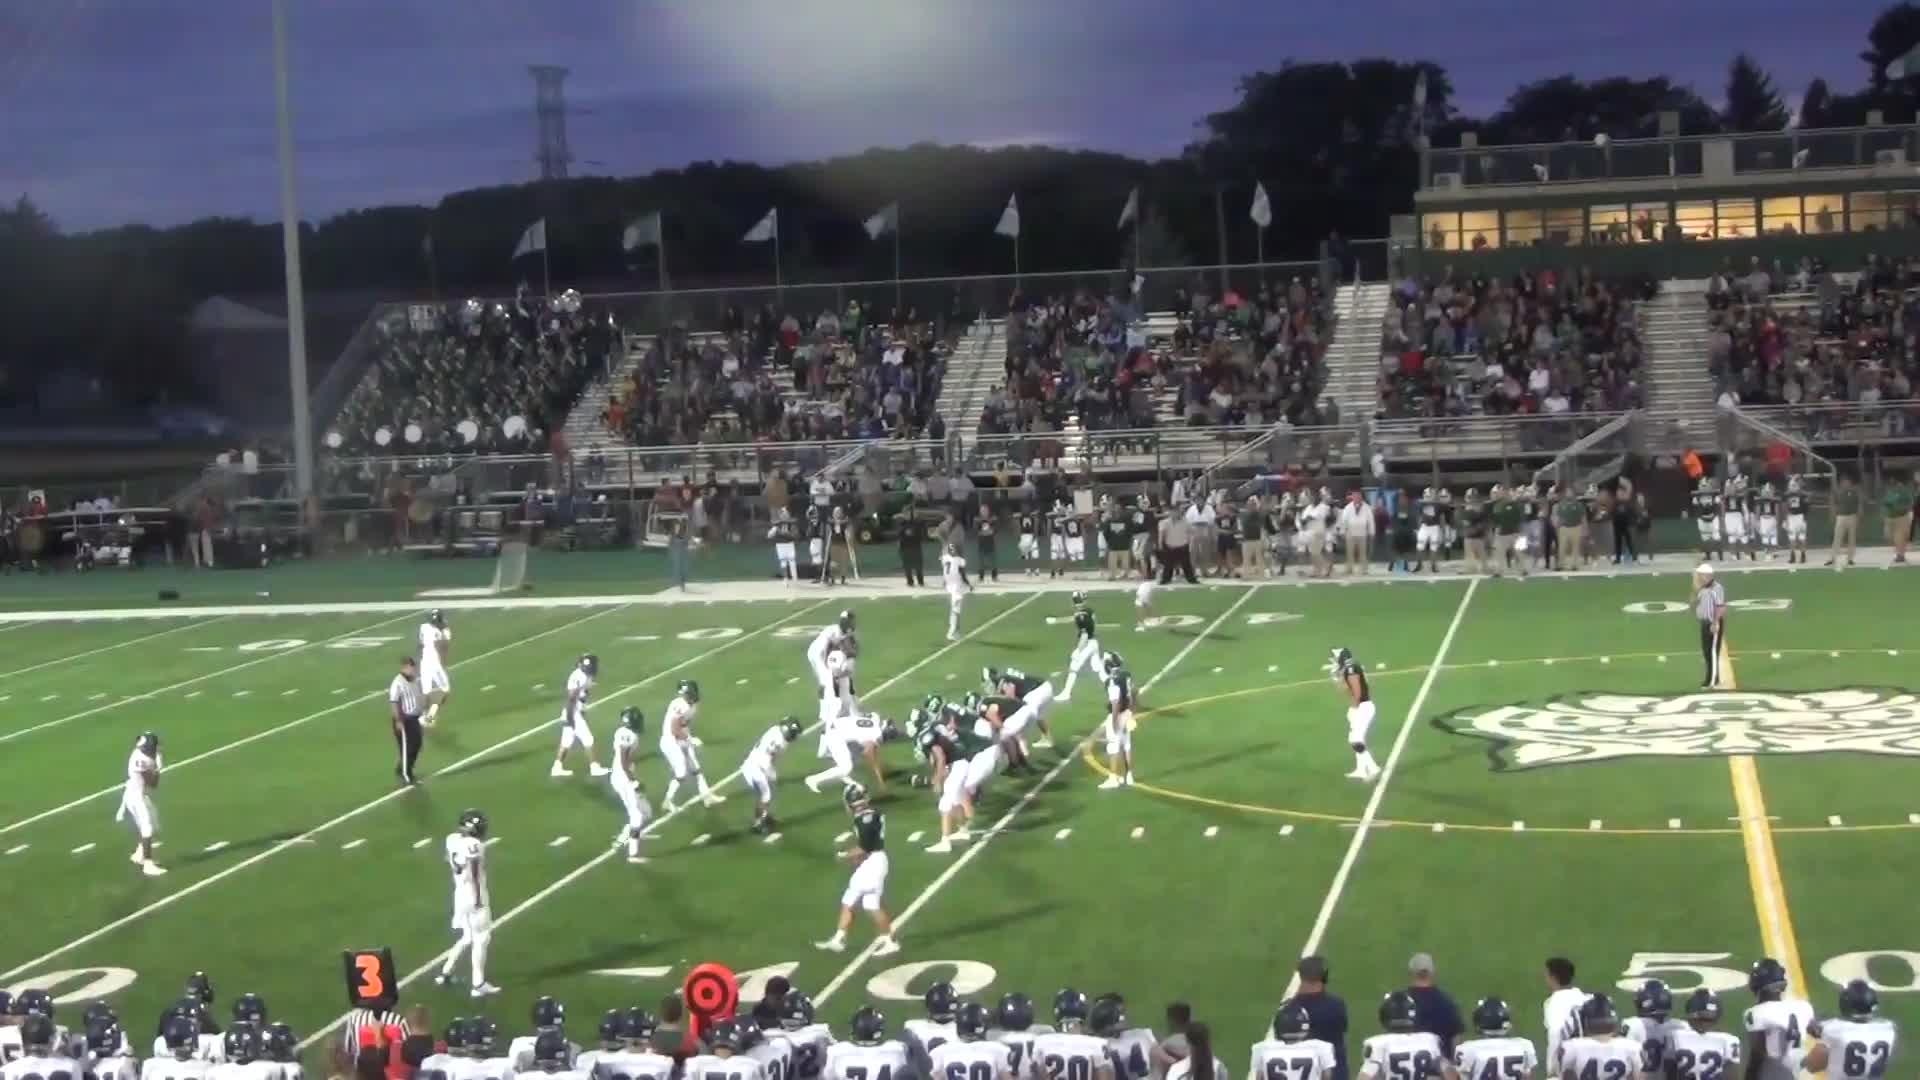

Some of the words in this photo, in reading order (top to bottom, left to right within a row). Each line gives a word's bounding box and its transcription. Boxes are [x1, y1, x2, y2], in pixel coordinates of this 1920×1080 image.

[355, 954, 384, 998] 3
[1266, 1057, 1313, 1080] 67
[1479, 1055, 1524, 1080] 45
[1675, 1048, 1722, 1080] 22
[1843, 1040, 1890, 1078] 62
